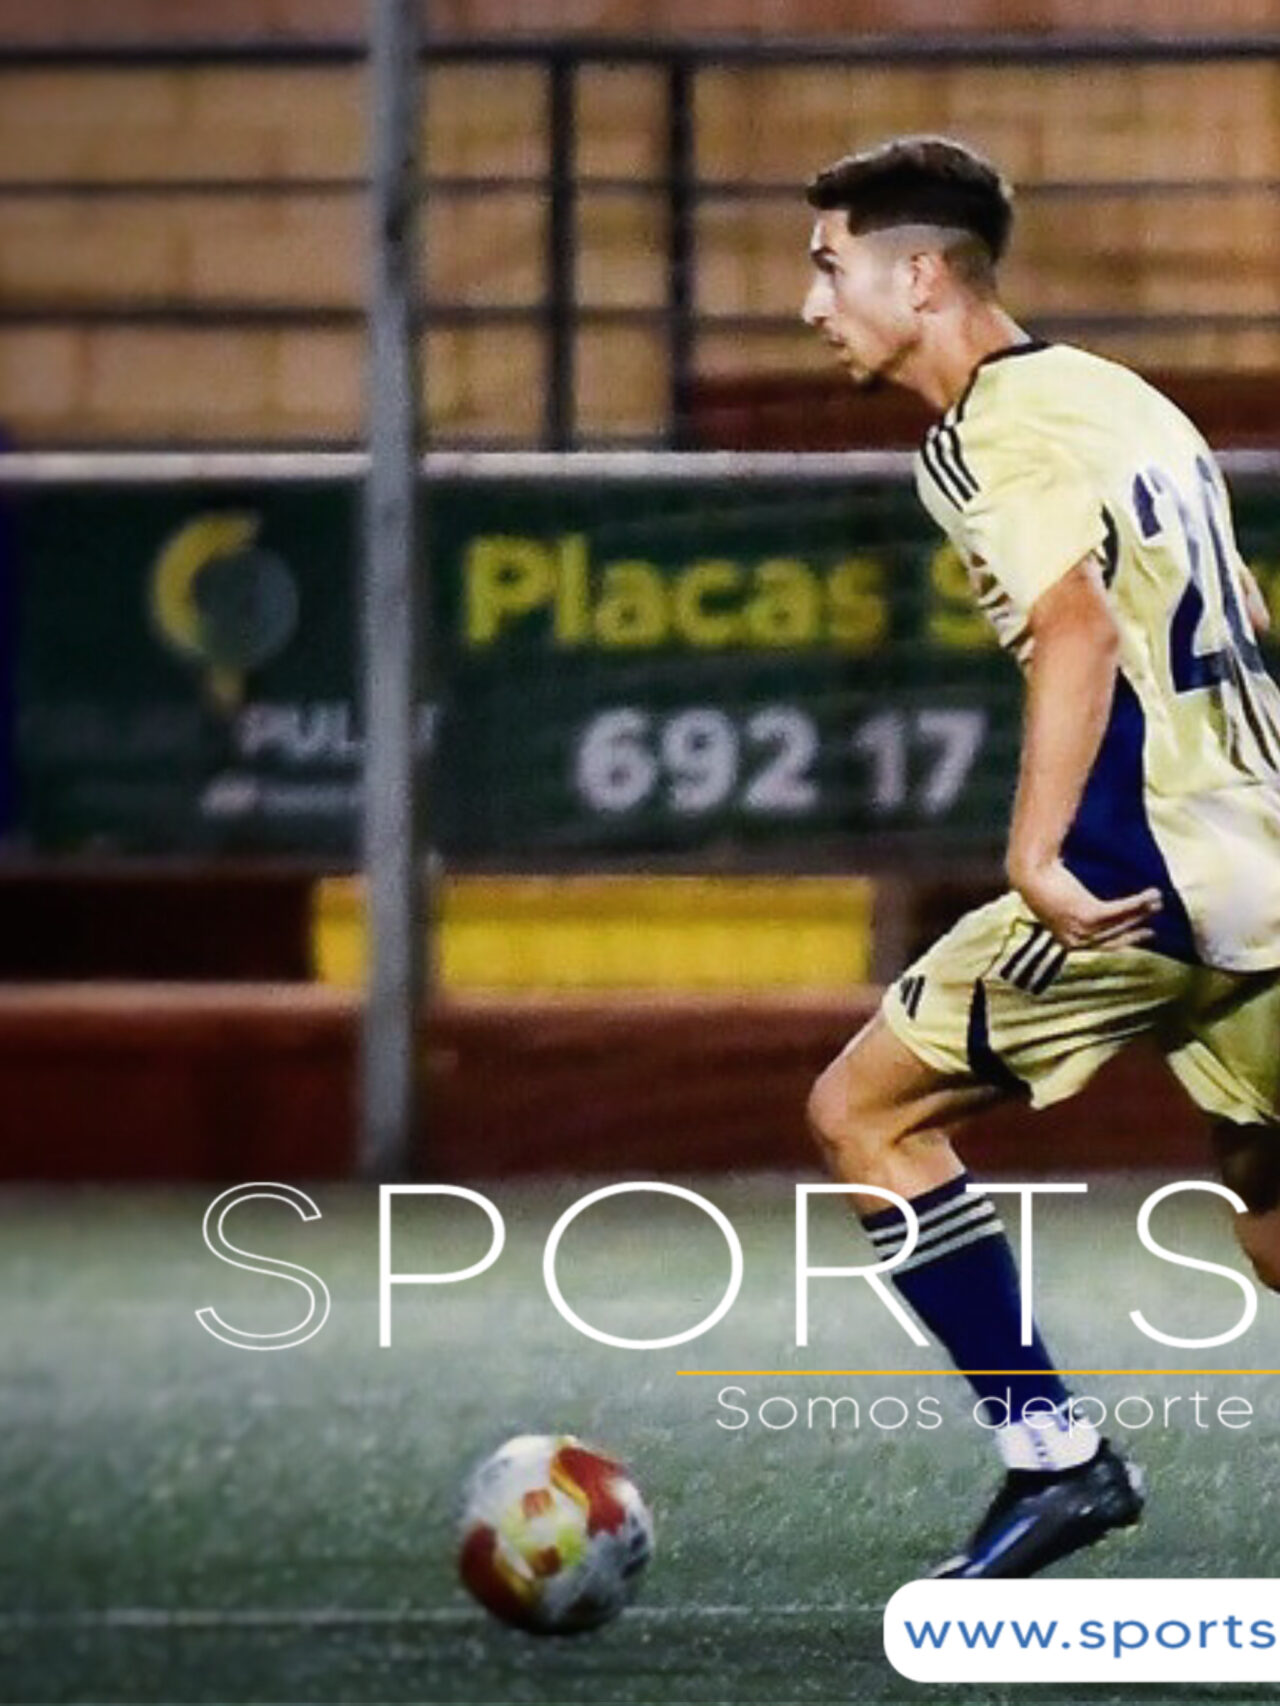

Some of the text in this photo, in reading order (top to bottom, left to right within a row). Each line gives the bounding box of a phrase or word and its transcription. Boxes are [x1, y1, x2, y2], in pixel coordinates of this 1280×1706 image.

[464, 533, 888, 648] Placas
[575, 707, 989, 813] 692 17
